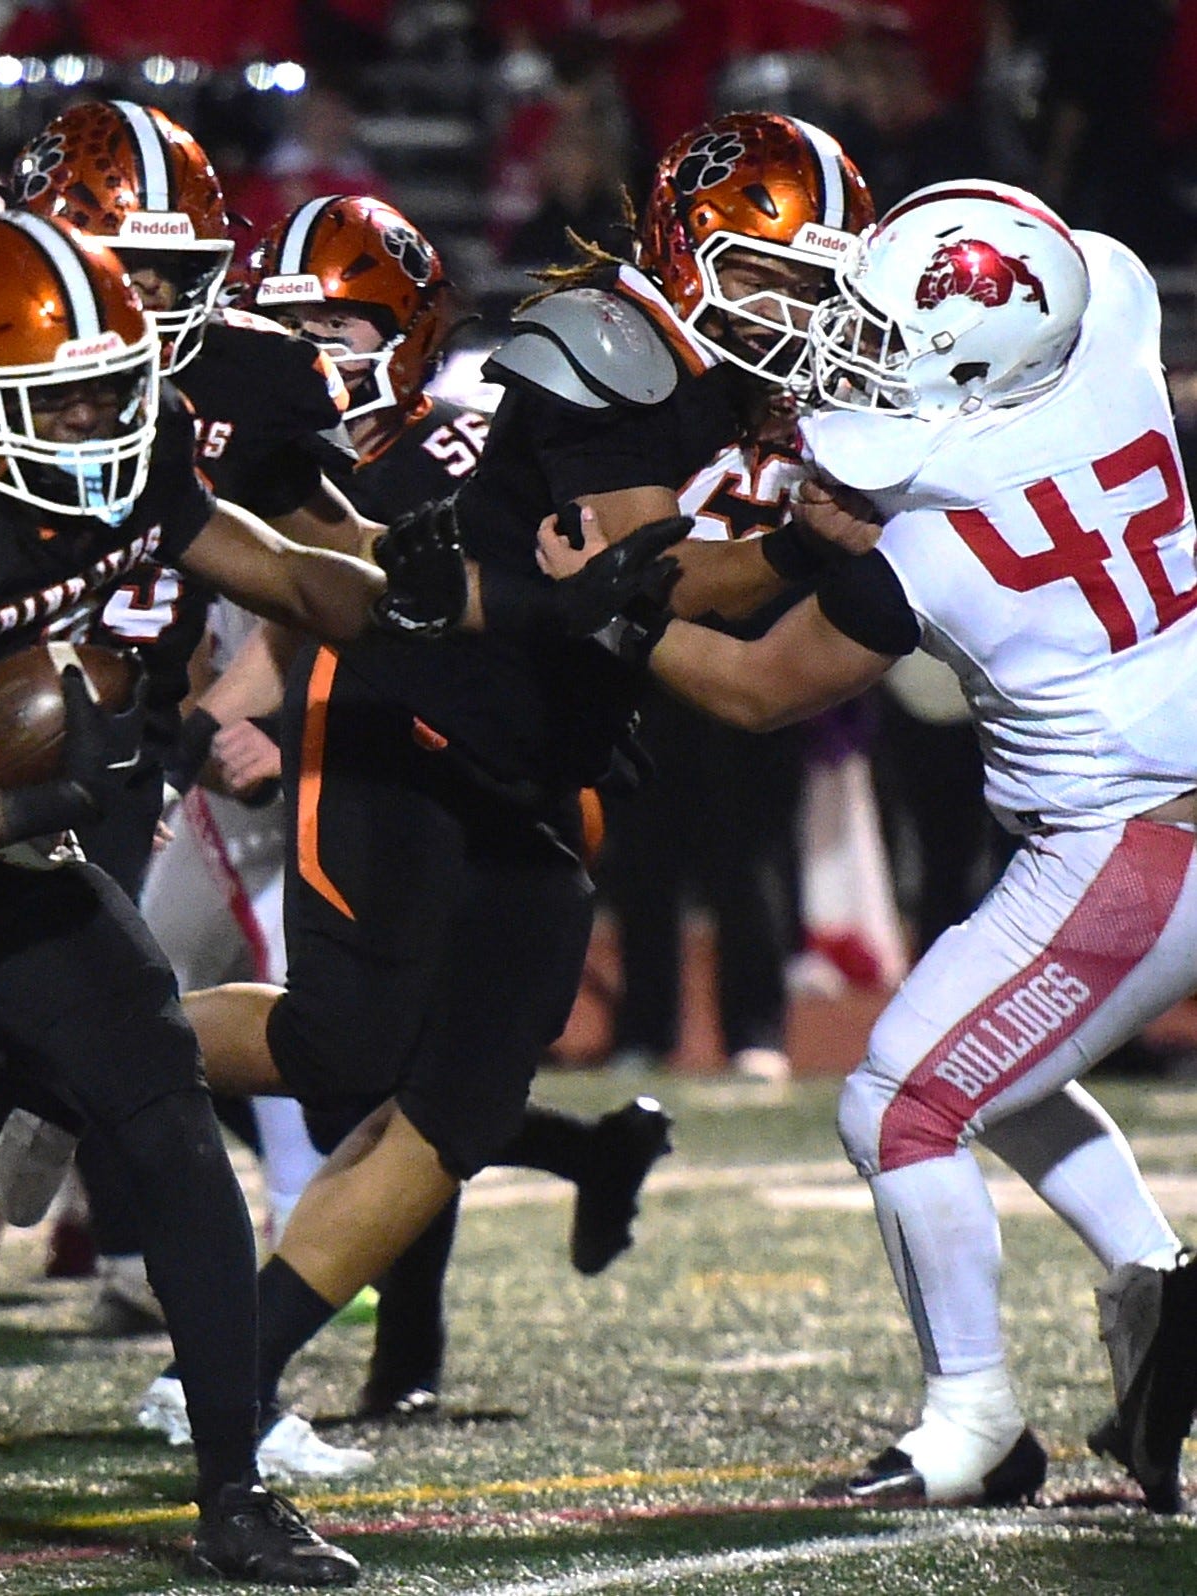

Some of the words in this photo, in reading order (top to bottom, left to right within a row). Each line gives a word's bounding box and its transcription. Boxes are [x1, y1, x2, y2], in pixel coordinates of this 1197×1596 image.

[130, 220, 189, 235] Riddell
[805, 230, 849, 252] Ridde
[262, 281, 314, 296] Riddell
[945, 429, 1197, 655] 42
[933, 961, 1091, 1100] BULLDOGS
